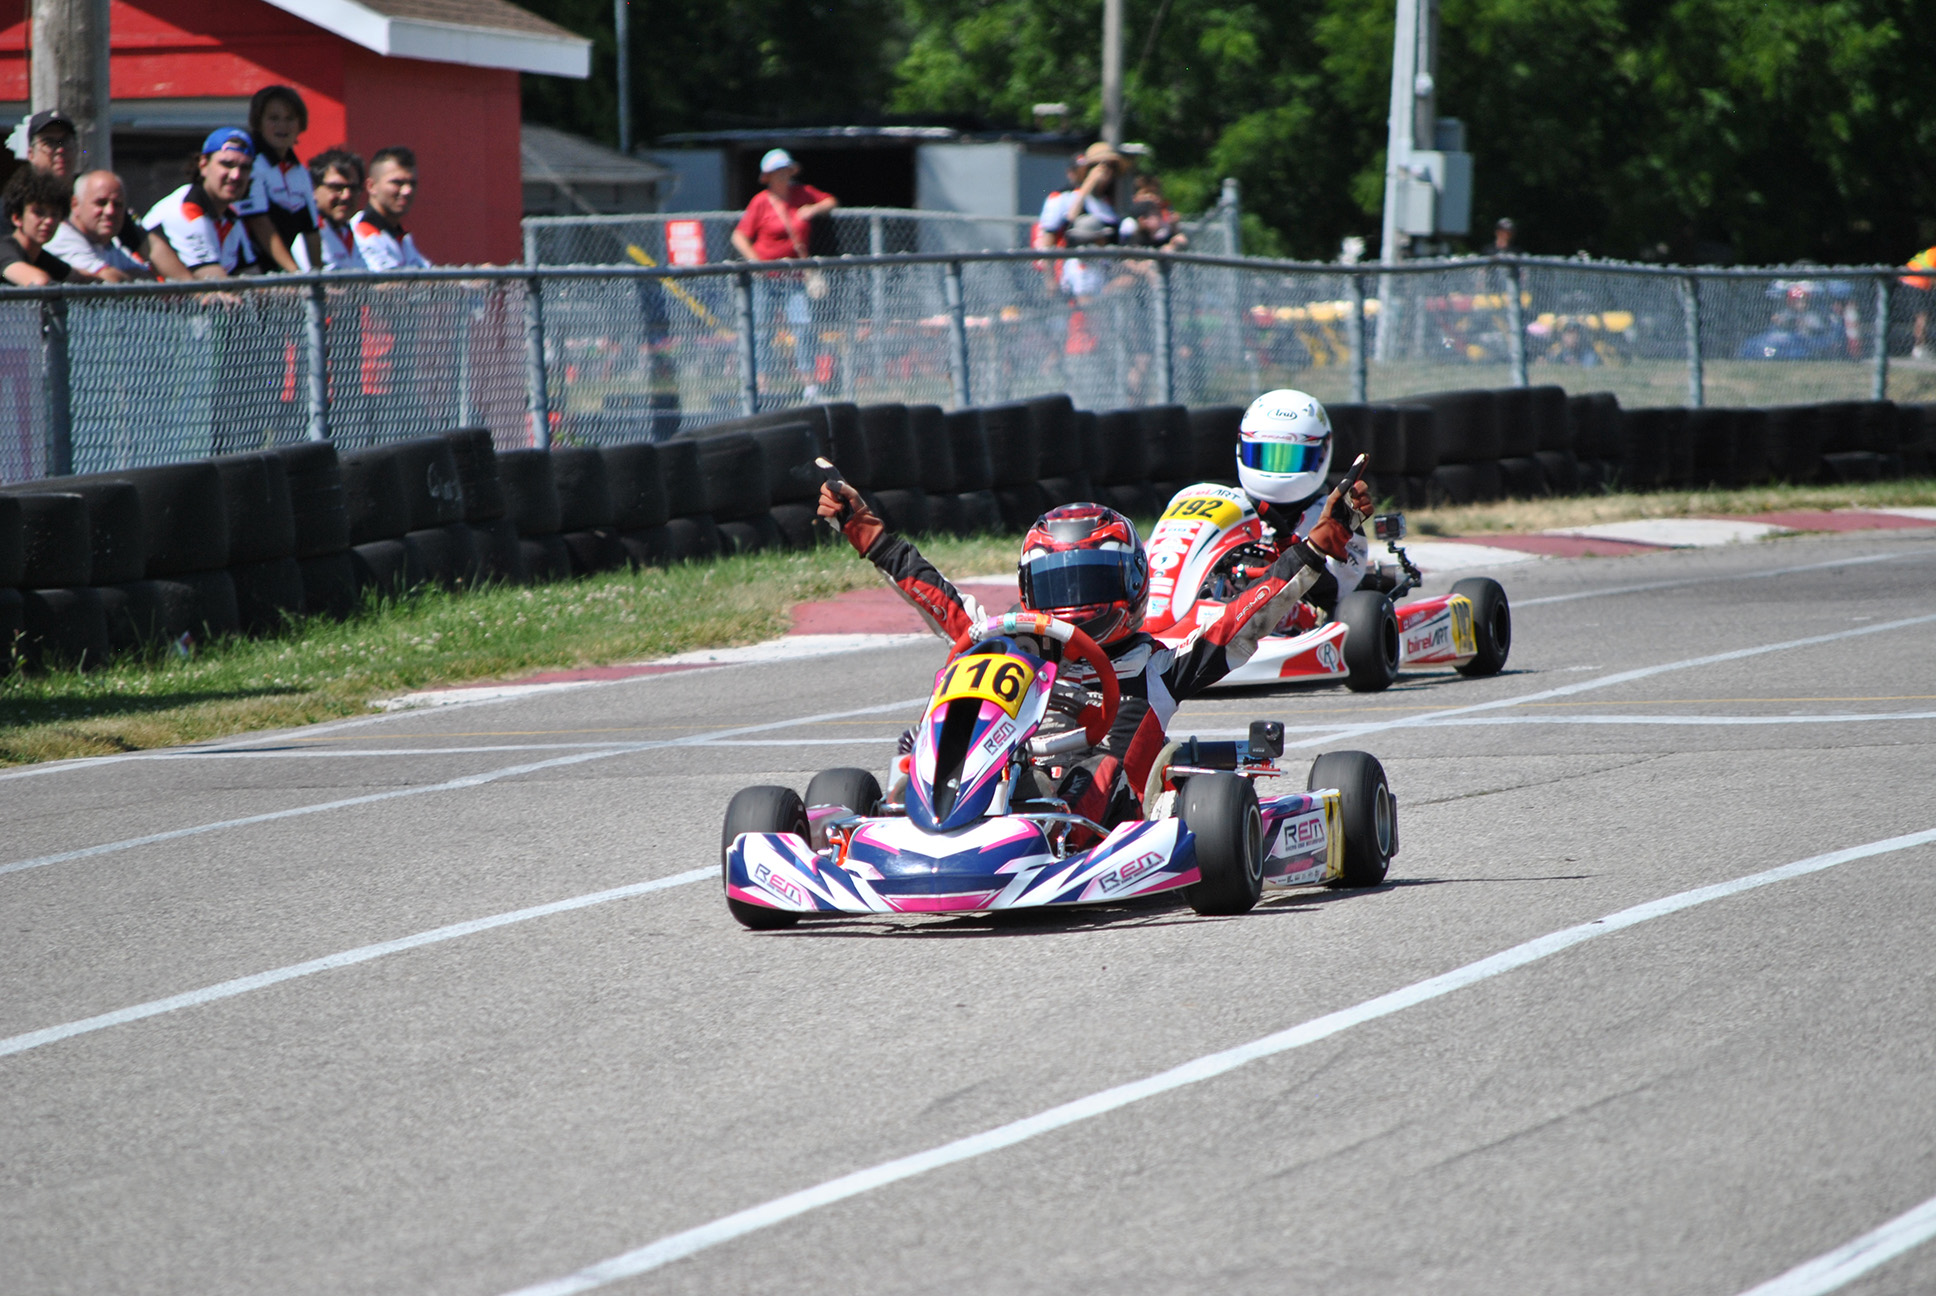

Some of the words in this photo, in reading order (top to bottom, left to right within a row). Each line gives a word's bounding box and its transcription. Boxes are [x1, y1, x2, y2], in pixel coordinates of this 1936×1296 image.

[1169, 499, 1224, 519] 192
[1235, 590, 1267, 622] PRIME
[938, 658, 1025, 703] 116
[983, 721, 1016, 753] REM
[1284, 818, 1325, 846] REM
[755, 862, 802, 904] REM
[1099, 851, 1163, 890] REM
